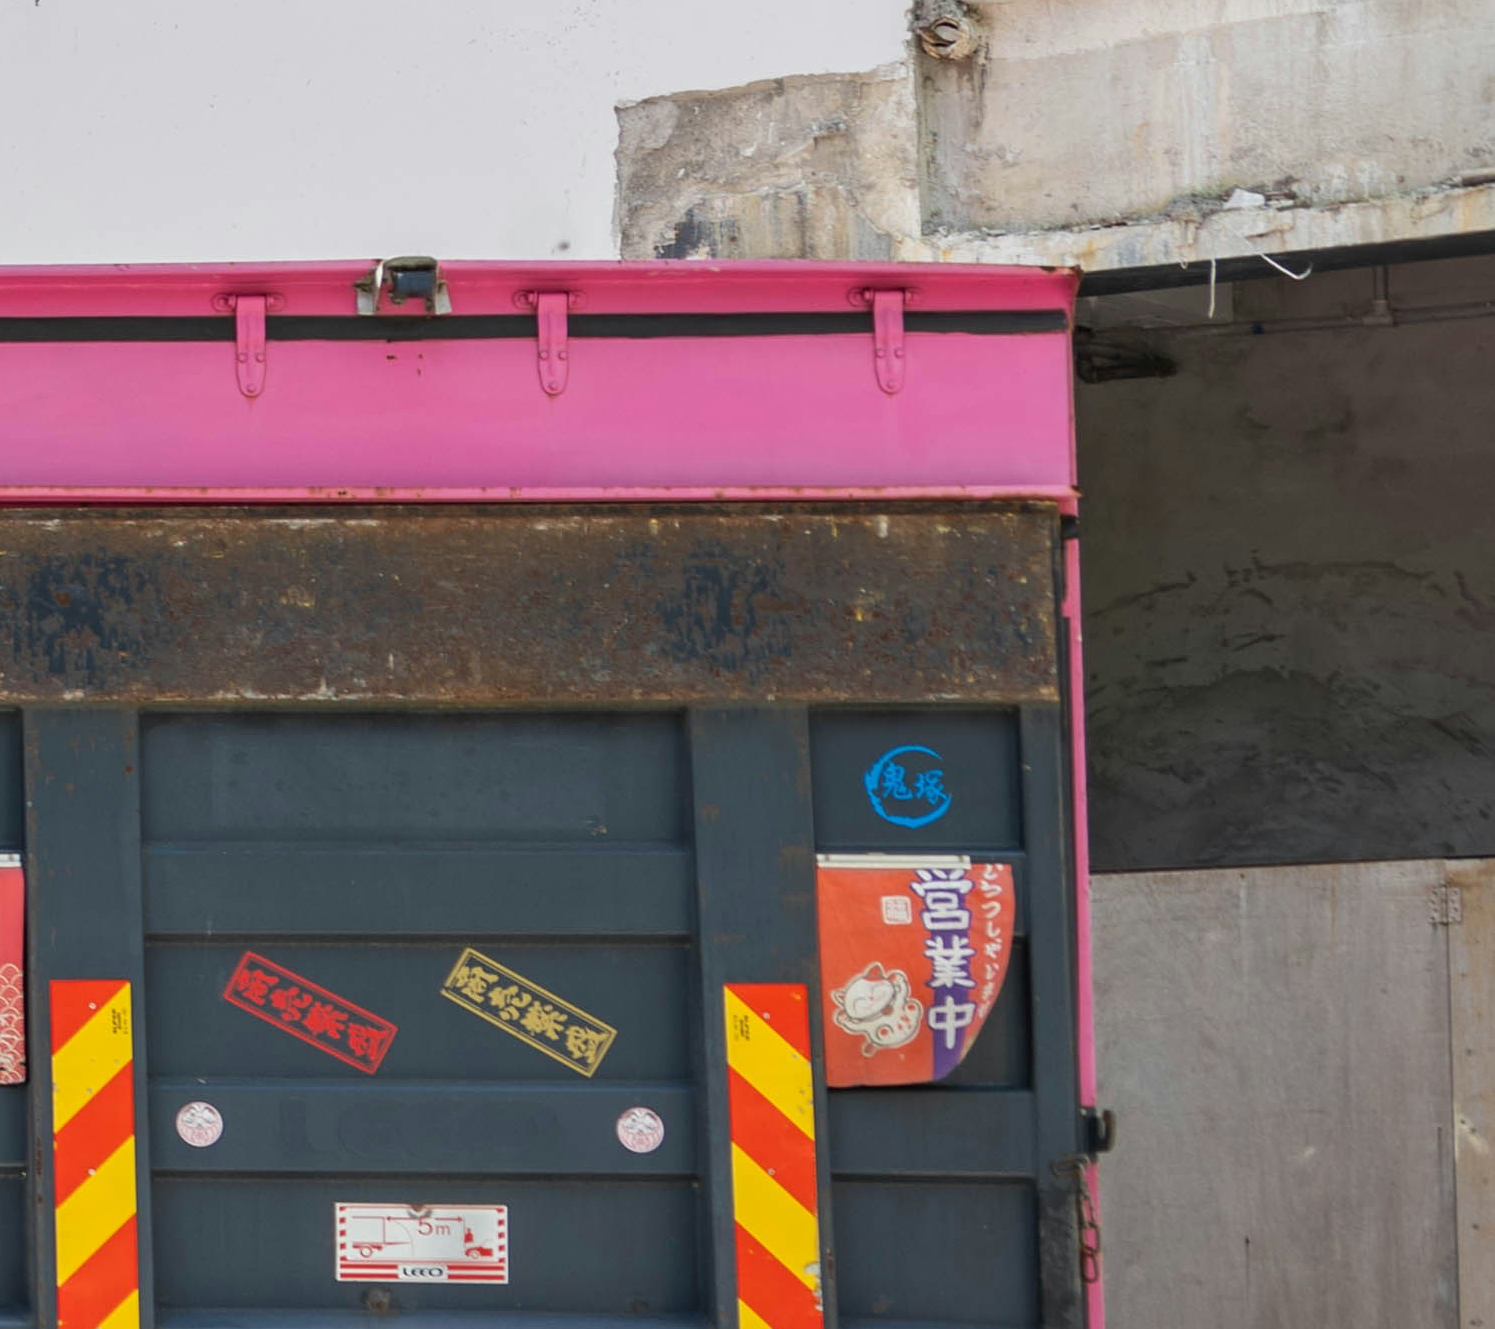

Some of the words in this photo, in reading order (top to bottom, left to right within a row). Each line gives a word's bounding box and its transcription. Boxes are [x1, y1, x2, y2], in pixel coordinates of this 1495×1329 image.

[881, 760, 948, 805] 鬼塚
[910, 867, 976, 1050] 営業中
